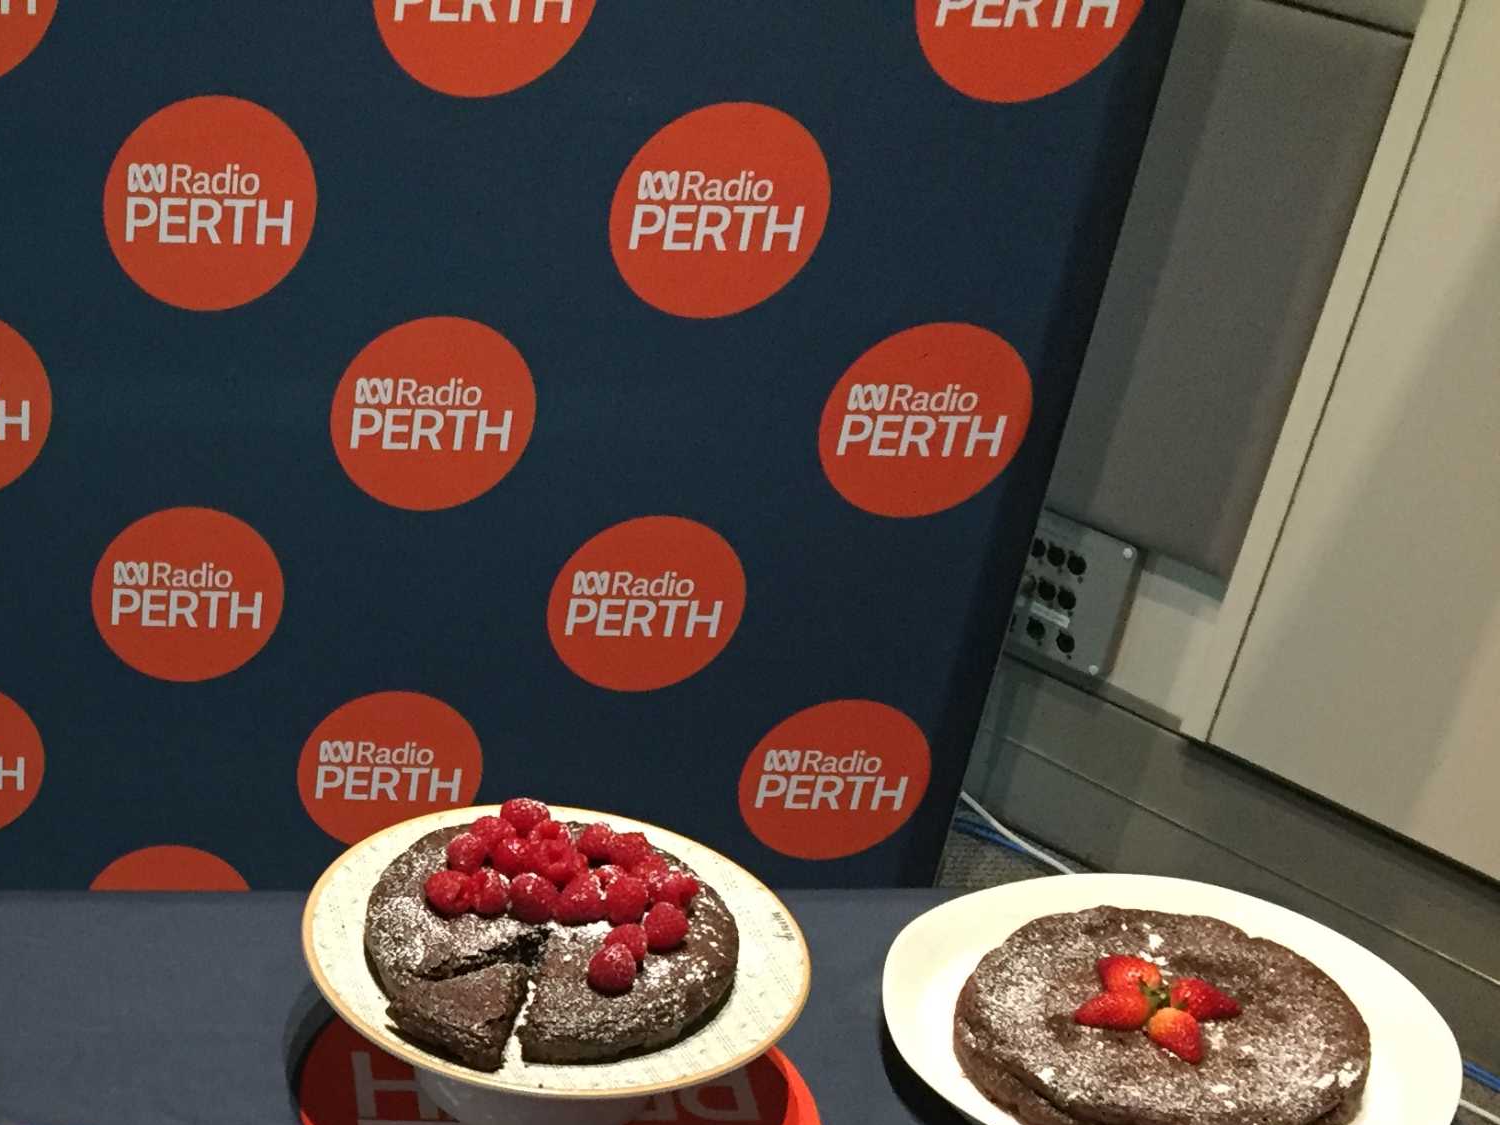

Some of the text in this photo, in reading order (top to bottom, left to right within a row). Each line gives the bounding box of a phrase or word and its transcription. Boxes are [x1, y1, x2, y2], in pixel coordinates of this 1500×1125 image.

[171, 163, 260, 195] Radio
[681, 170, 773, 202] Radio
[125, 196, 293, 246] PERTH
[628, 203, 805, 252] PERTH
[396, 377, 483, 406] Radio
[889, 383, 979, 412] Radio
[350, 407, 514, 452] PERTH
[836, 413, 1008, 458] PERTH
[152, 561, 234, 588] Radio
[611, 570, 695, 597] Radio
[110, 588, 263, 629] PERTH
[564, 598, 724, 638] PERTH
[356, 740, 435, 766] Radio
[801, 750, 882, 774] Radio
[314, 765, 463, 803] PERTH
[753, 774, 909, 811] PERTH
